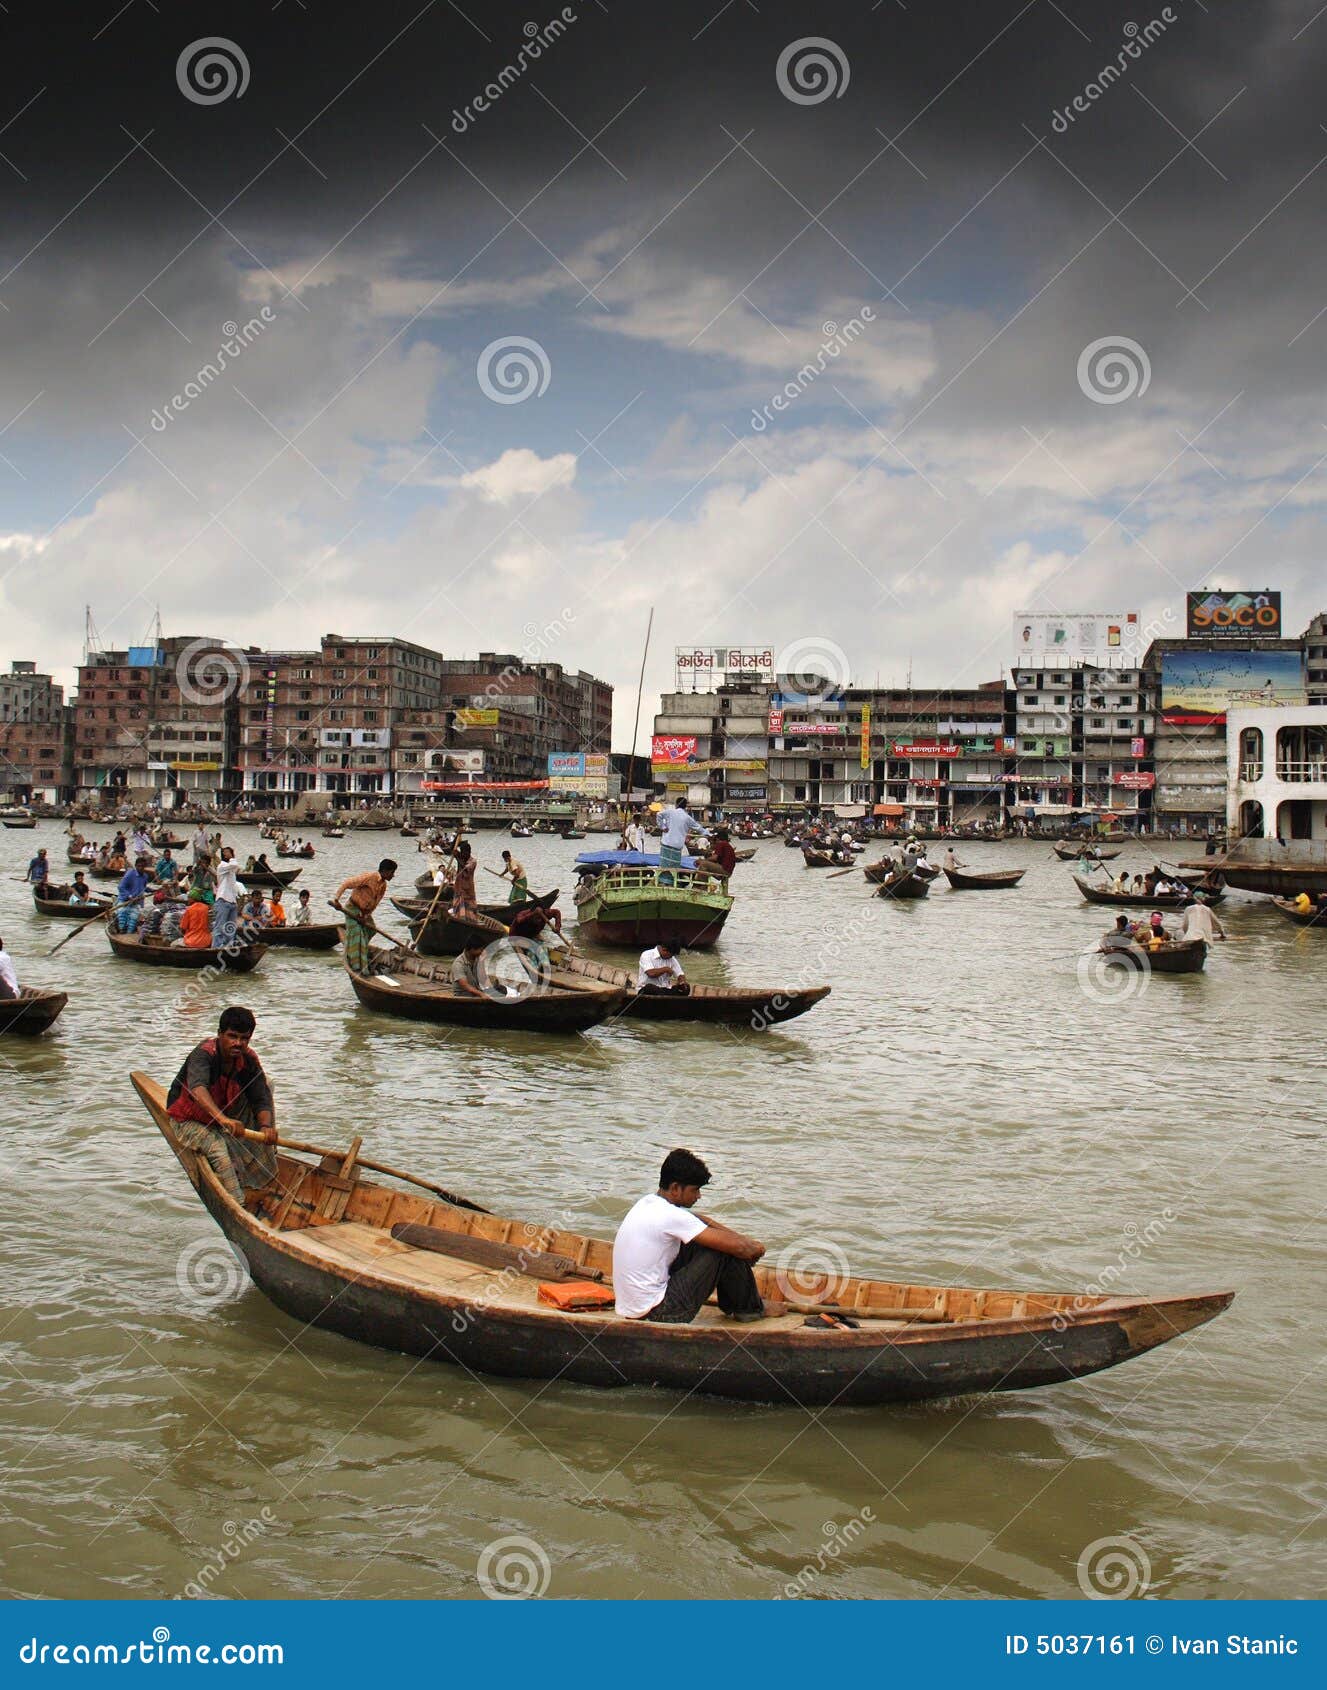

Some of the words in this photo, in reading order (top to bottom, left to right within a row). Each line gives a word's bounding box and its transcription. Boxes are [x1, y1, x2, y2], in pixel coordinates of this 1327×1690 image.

[1193, 606, 1278, 626] SOCO
[677, 650, 714, 668] ক্রাউন
[728, 650, 772, 668] সিমেন্ট
